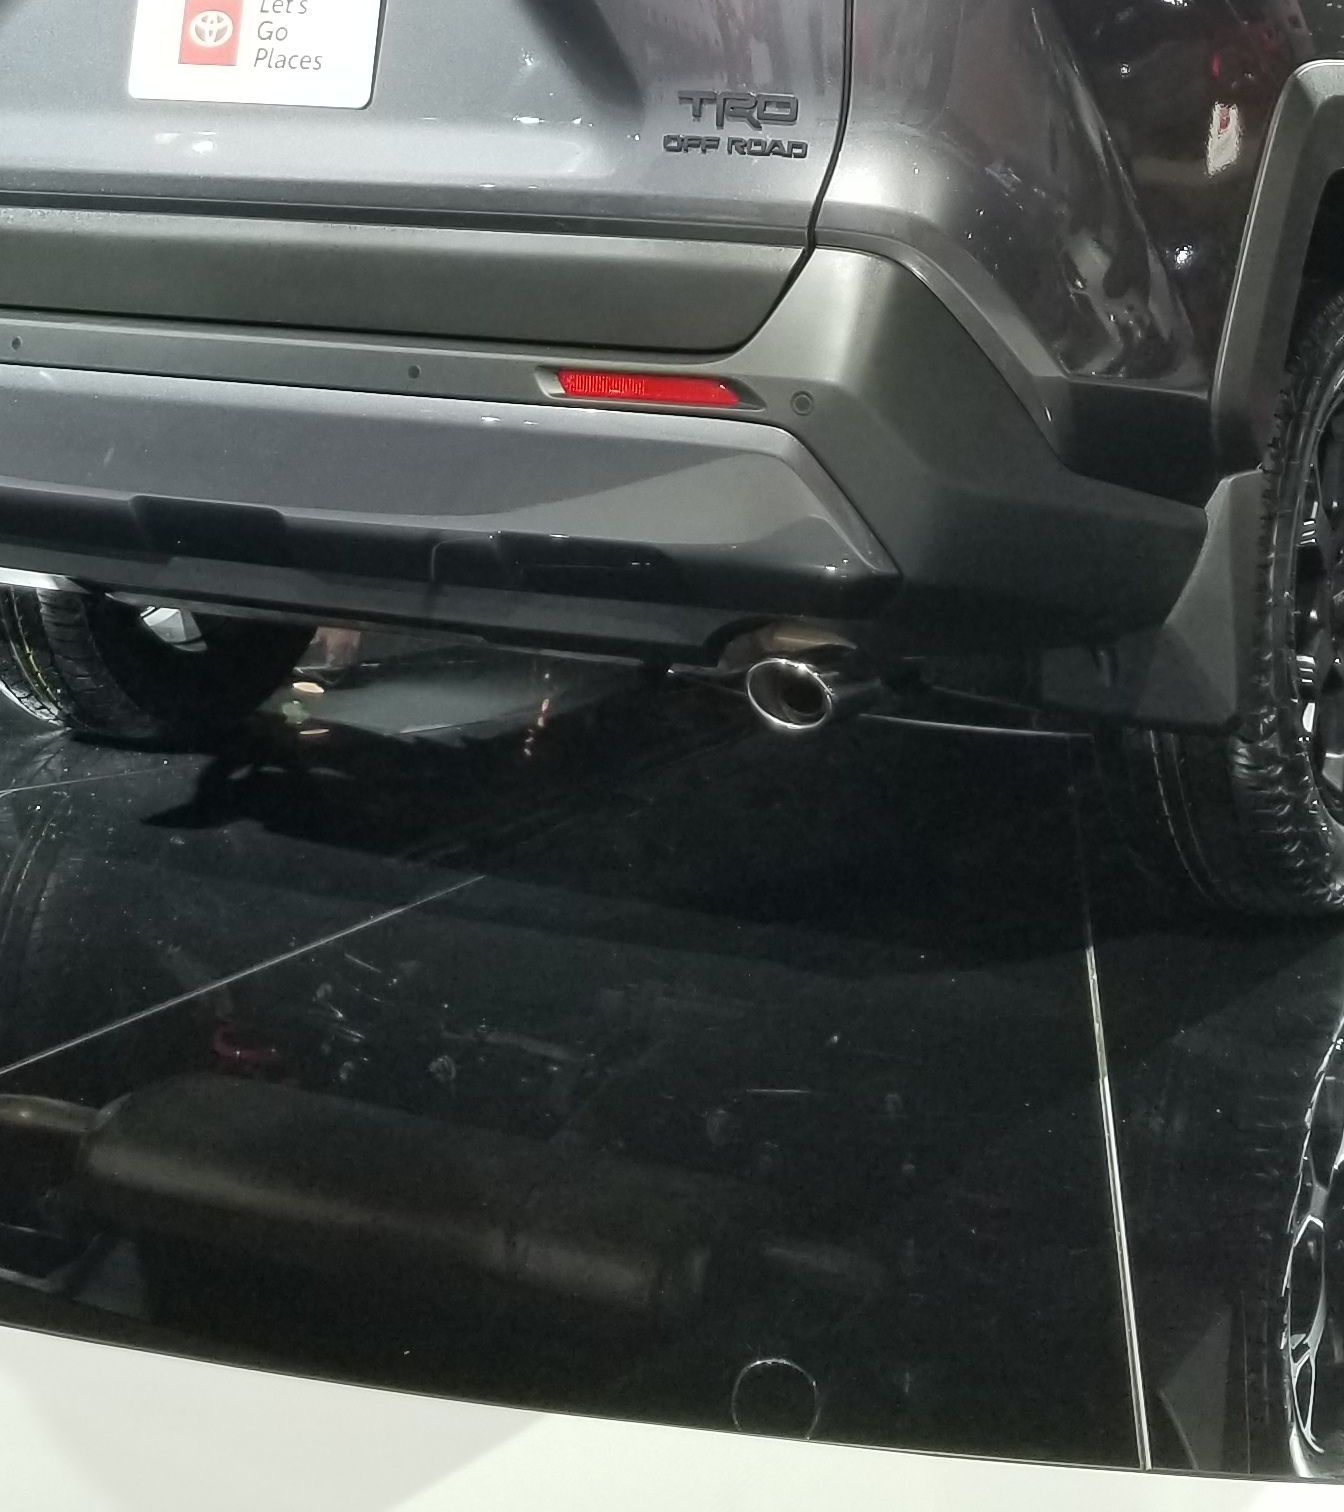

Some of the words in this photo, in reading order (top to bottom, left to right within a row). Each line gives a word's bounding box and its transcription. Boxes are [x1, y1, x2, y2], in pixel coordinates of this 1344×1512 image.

[257, 20, 289, 42] Go
[253, 48, 323, 71] Places
[677, 90, 799, 131] TRD
[663, 134, 721, 154] OFF
[727, 136, 809, 159] ROAD
